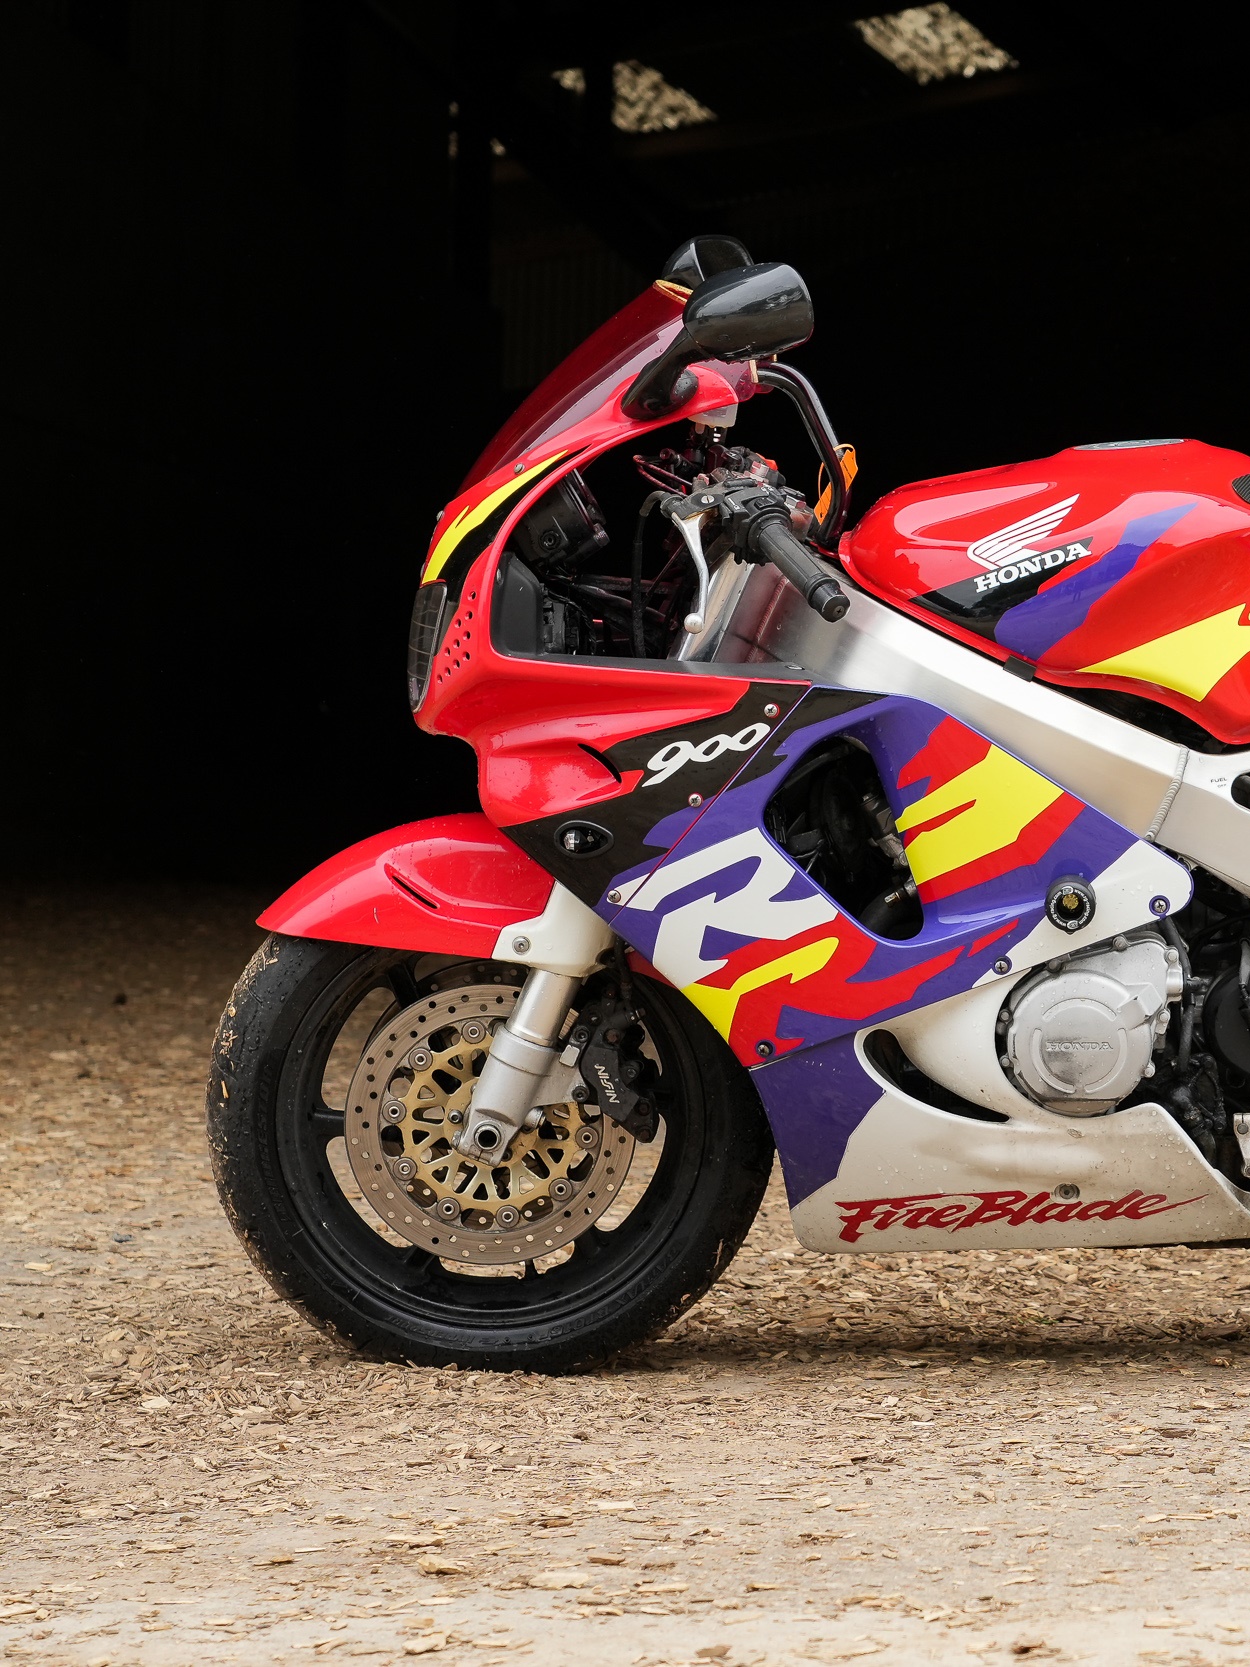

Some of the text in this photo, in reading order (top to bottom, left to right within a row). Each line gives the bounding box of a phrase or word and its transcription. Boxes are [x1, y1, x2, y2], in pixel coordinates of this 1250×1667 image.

[974, 543, 1092, 593] HONDA
[641, 722, 771, 787] 900
[1045, 1041, 1114, 1051] HONDA
[594, 1063, 620, 1103] NISSIN
[835, 1189, 1209, 1243] FireBlade
